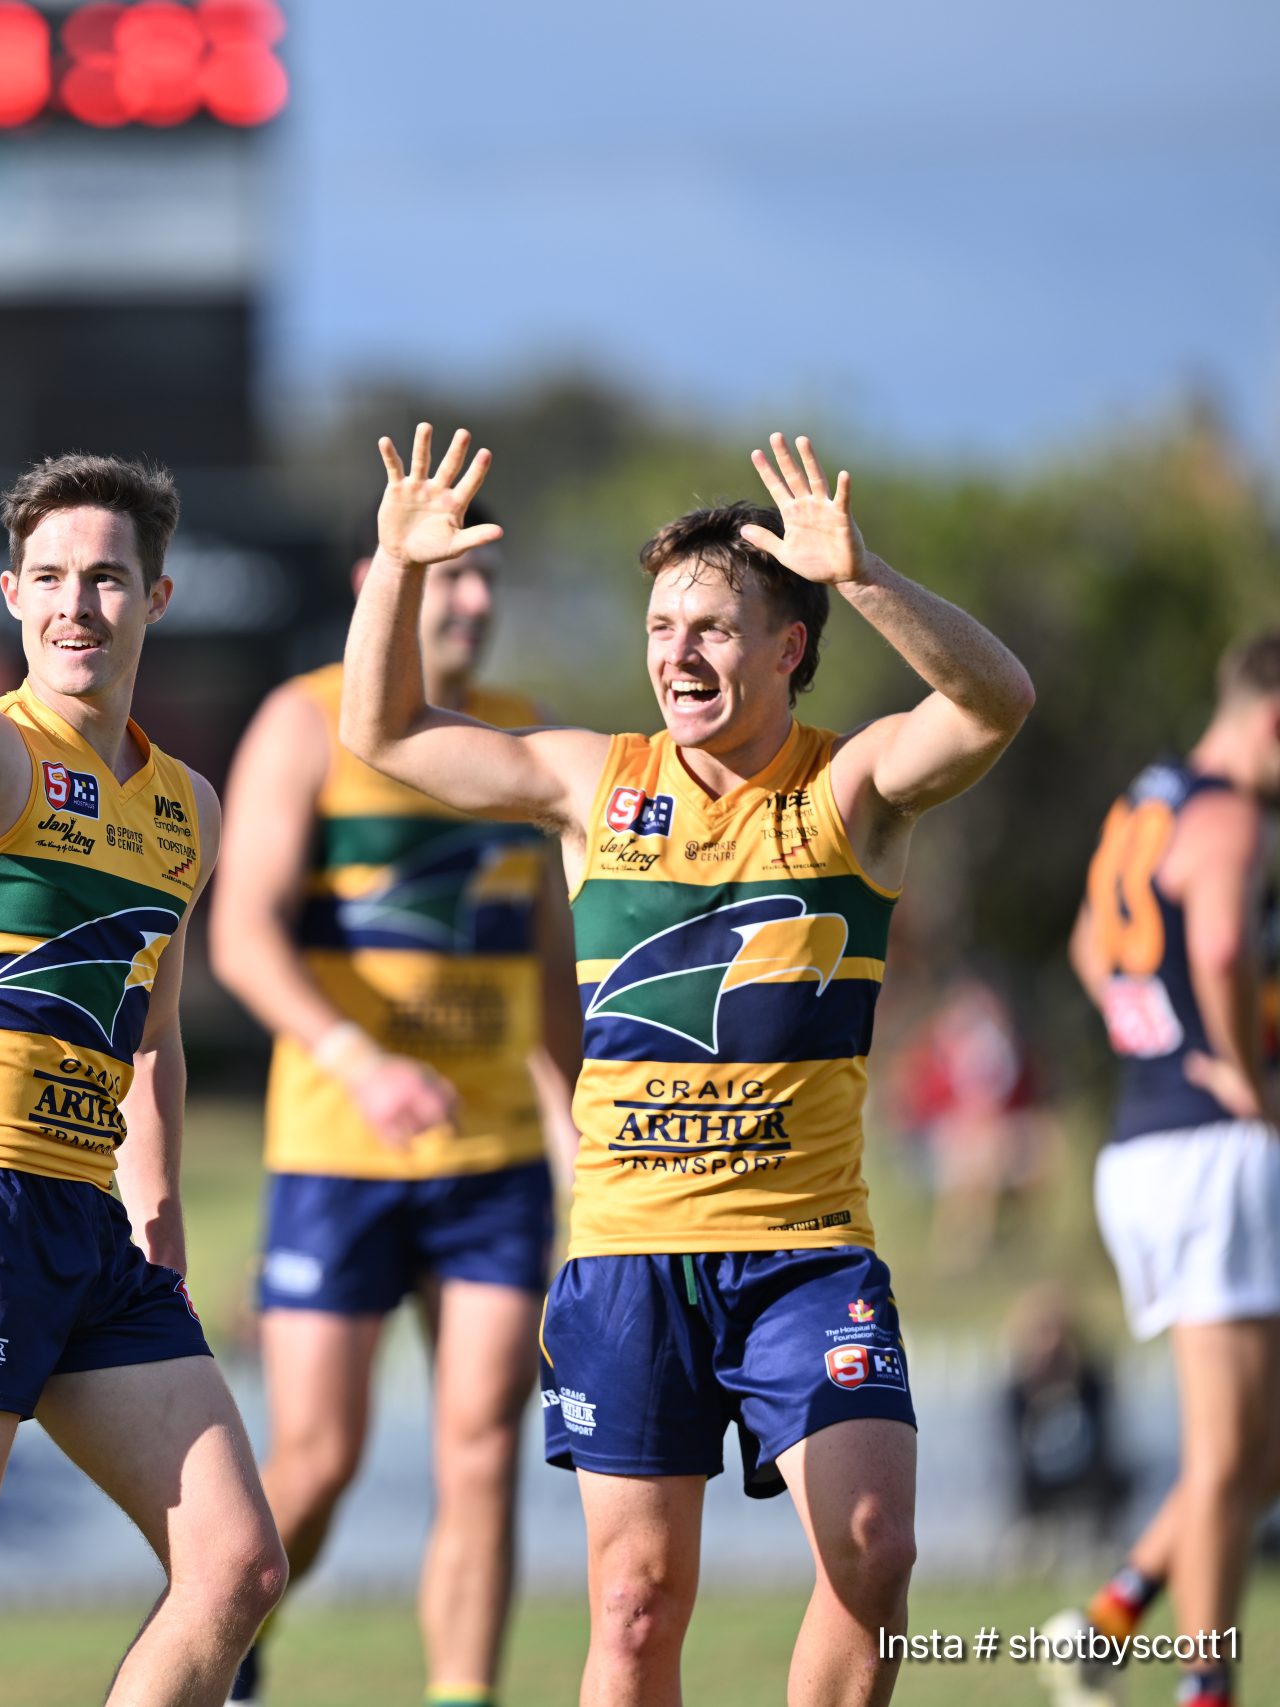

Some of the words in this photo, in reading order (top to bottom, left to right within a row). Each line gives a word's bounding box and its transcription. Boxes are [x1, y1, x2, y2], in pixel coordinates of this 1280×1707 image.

[117, 826, 143, 843] SPORTS
[118, 838, 144, 855] CENTRE
[646, 1079, 764, 1099] CRAIG
[616, 1112, 789, 1143] ARTHUR
[614, 1155, 786, 1175] TRANSPORT
[833, 1332, 875, 1342] Foundation
[840, 1324, 870, 1334] Hospital
[560, 1387, 586, 1402] CRAIG
